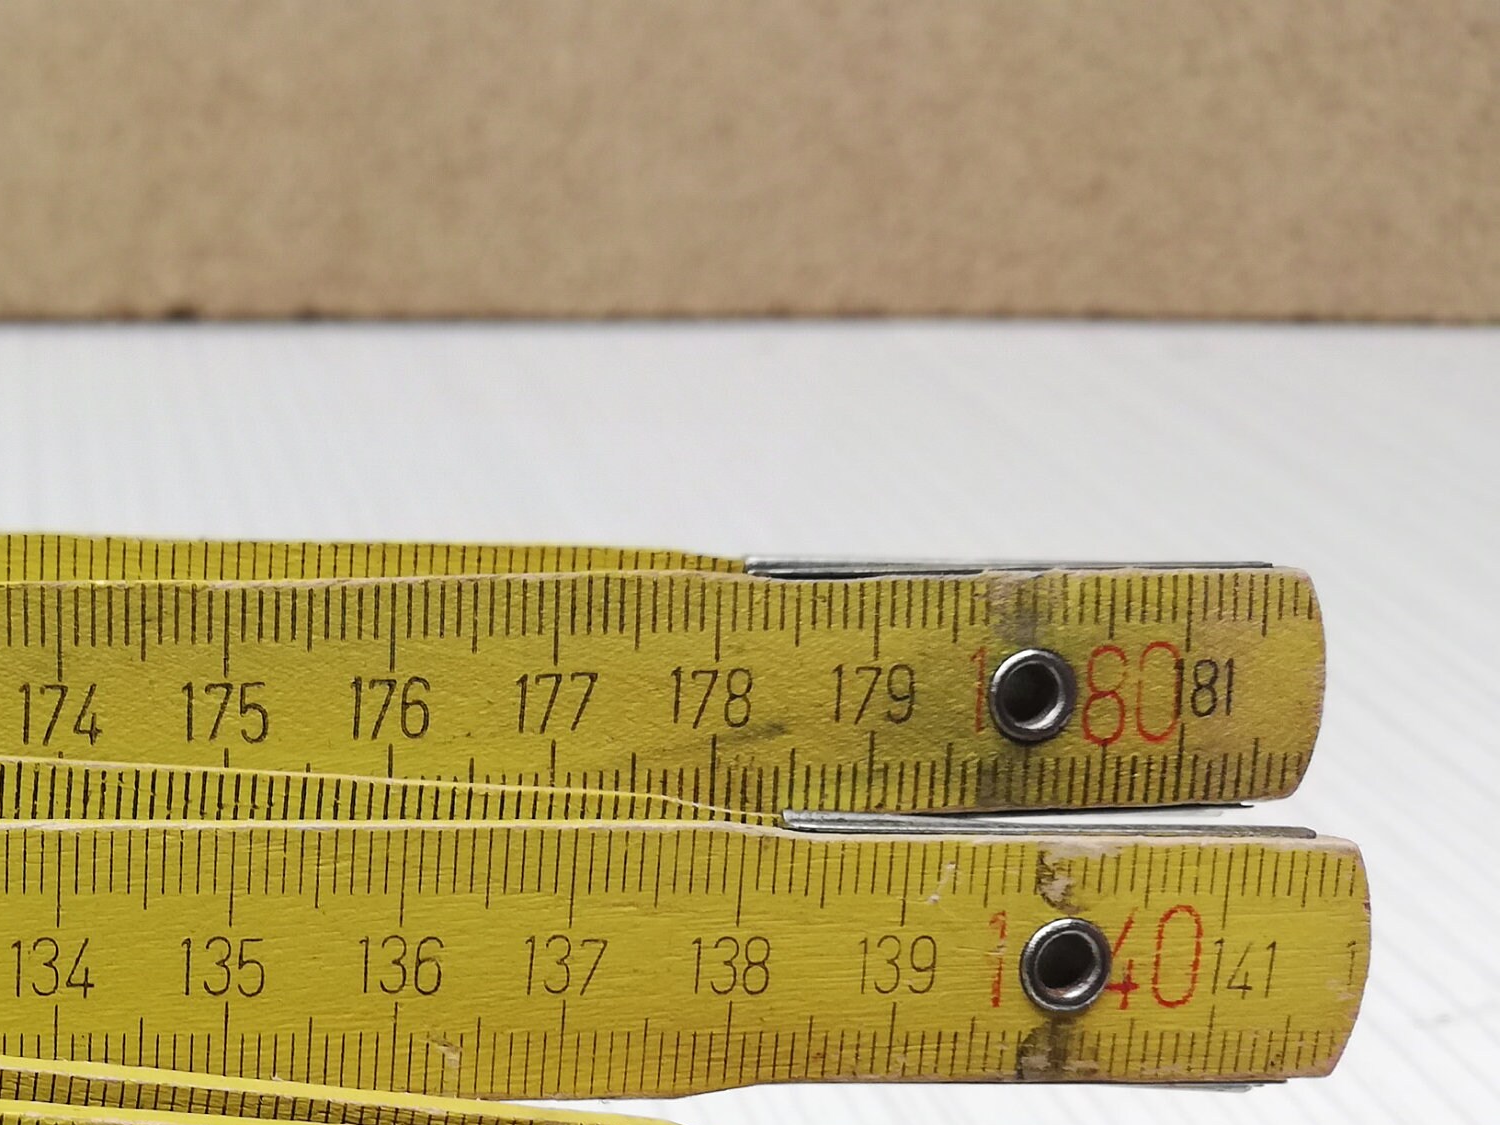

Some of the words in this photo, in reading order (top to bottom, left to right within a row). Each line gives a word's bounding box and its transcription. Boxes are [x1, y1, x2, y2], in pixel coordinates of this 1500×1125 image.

[20, 681, 101, 746] 174
[181, 681, 269, 743] 175
[351, 675, 431, 739] 176
[517, 672, 598, 733] 177
[671, 666, 753, 729] 178
[832, 663, 915, 724] 179
[971, 641, 1181, 745] 180
[11, 937, 95, 997] 134
[181, 937, 266, 997] 135
[358, 936, 445, 997] 136
[525, 935, 608, 997] 137
[691, 936, 770, 996] 138
[858, 936, 938, 995] 139
[989, 904, 1203, 1010] 140
[1214, 937, 1277, 999] 141
